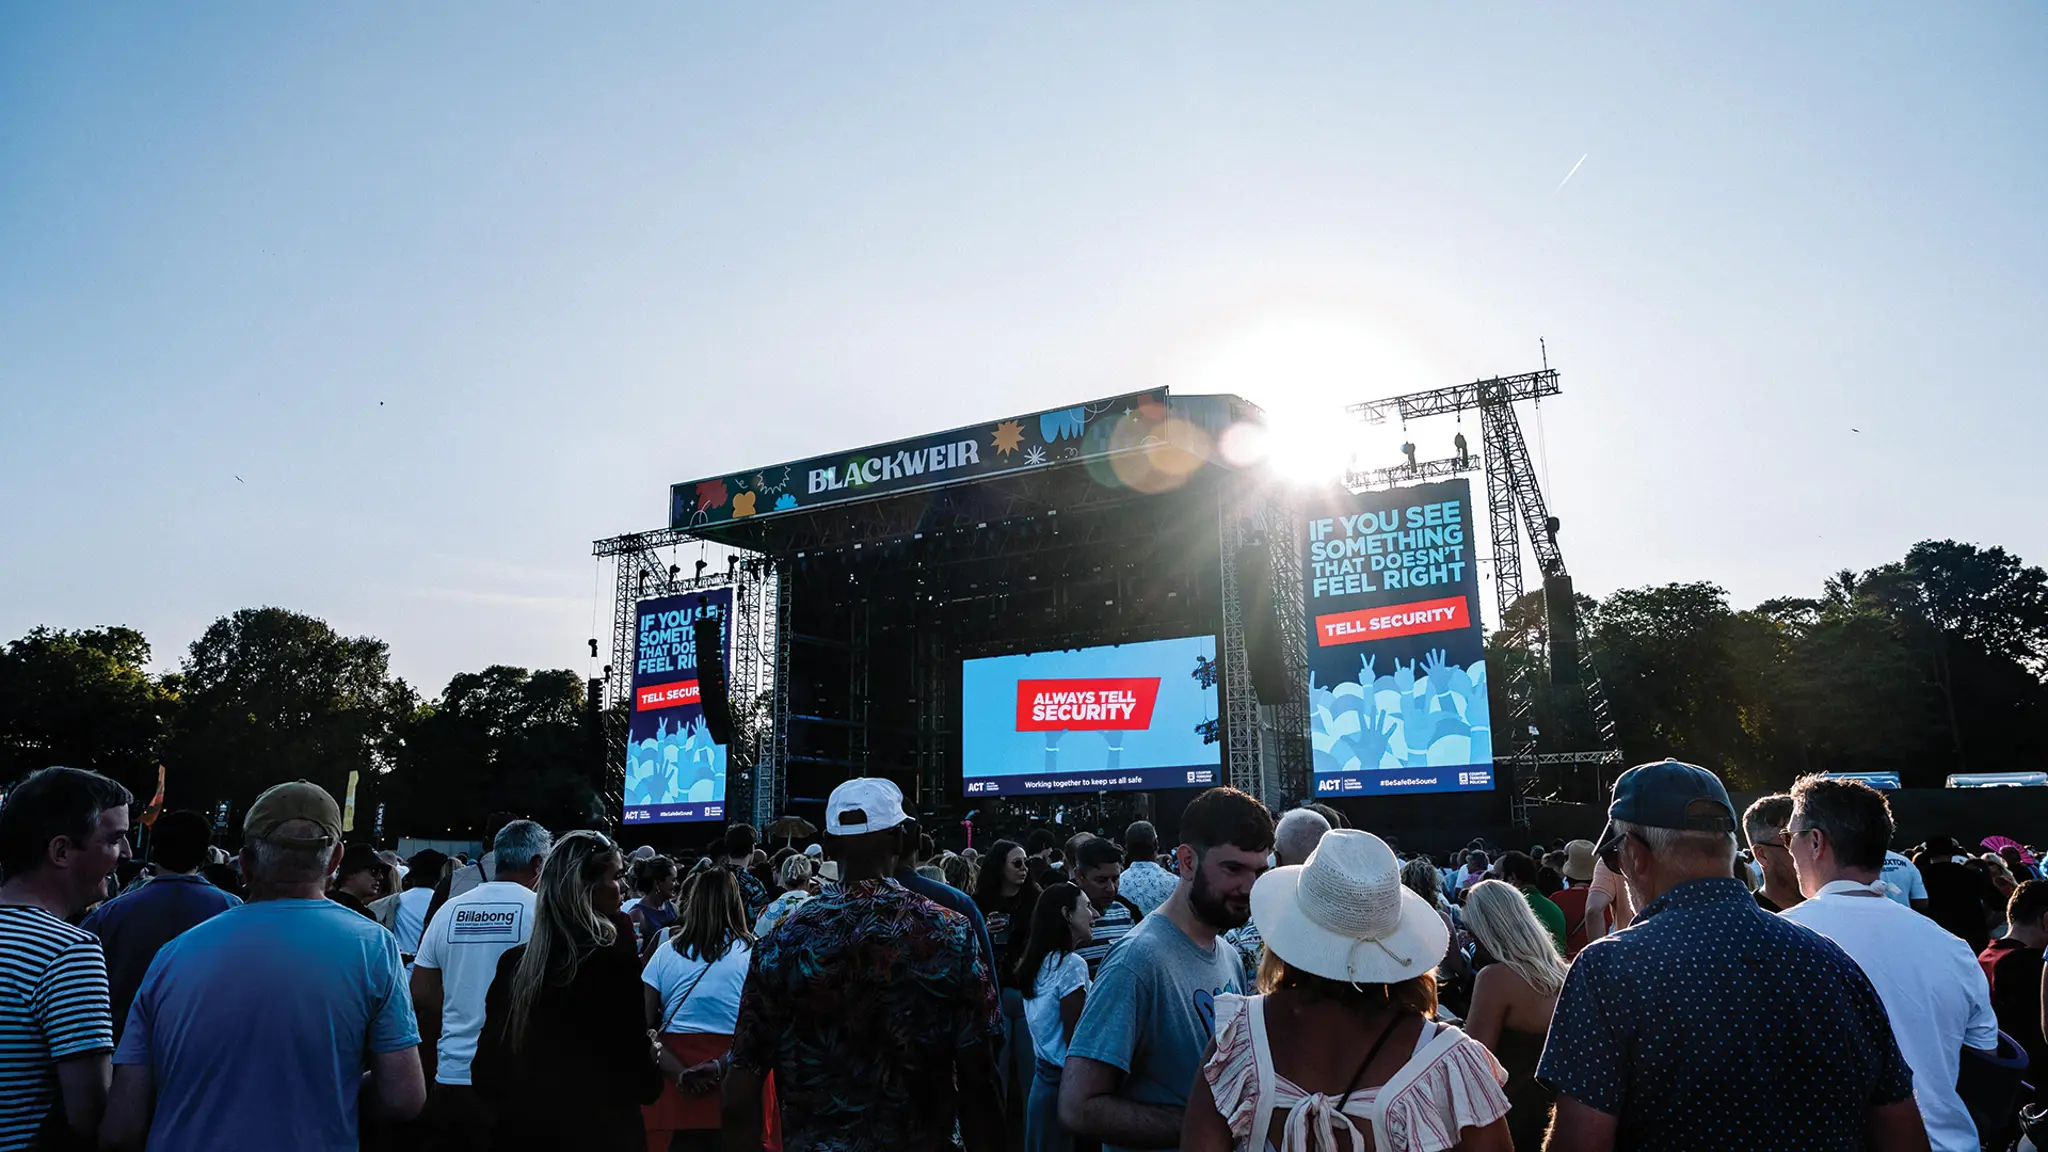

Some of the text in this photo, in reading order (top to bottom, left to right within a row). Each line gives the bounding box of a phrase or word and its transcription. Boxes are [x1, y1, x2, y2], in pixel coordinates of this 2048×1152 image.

[808, 439, 980, 494] BLACKWEIR
[1309, 500, 1461, 541] IF YOU SEE
[1311, 524, 1464, 561] SOMETHING
[1312, 545, 1464, 578] THAT DOESN’T
[1313, 562, 1465, 598] FEEL RIGHT
[640, 614, 655, 631] IF
[658, 608, 692, 629] YOU
[1325, 606, 1456, 637] TELL SECURITY
[639, 644, 670, 659] THAT
[638, 656, 674, 674] FEEL
[642, 686, 700, 704] TELL SECUR
[1033, 690, 1136, 705] ALWAYS TELL
[1032, 703, 1136, 721] SECURITY
[968, 782, 984, 792] ACT
[1024, 781, 1051, 789] Working
[1053, 779, 1081, 788] together
[1091, 778, 1107, 786] keep
[1118, 776, 1126, 784] all
[1128, 776, 1142, 784] safe
[1318, 779, 1341, 792] ACT
[1380, 777, 1437, 786] #BeSafeBeSound
[624, 811, 638, 820] ACT
[456, 910, 514, 925] Billabong
